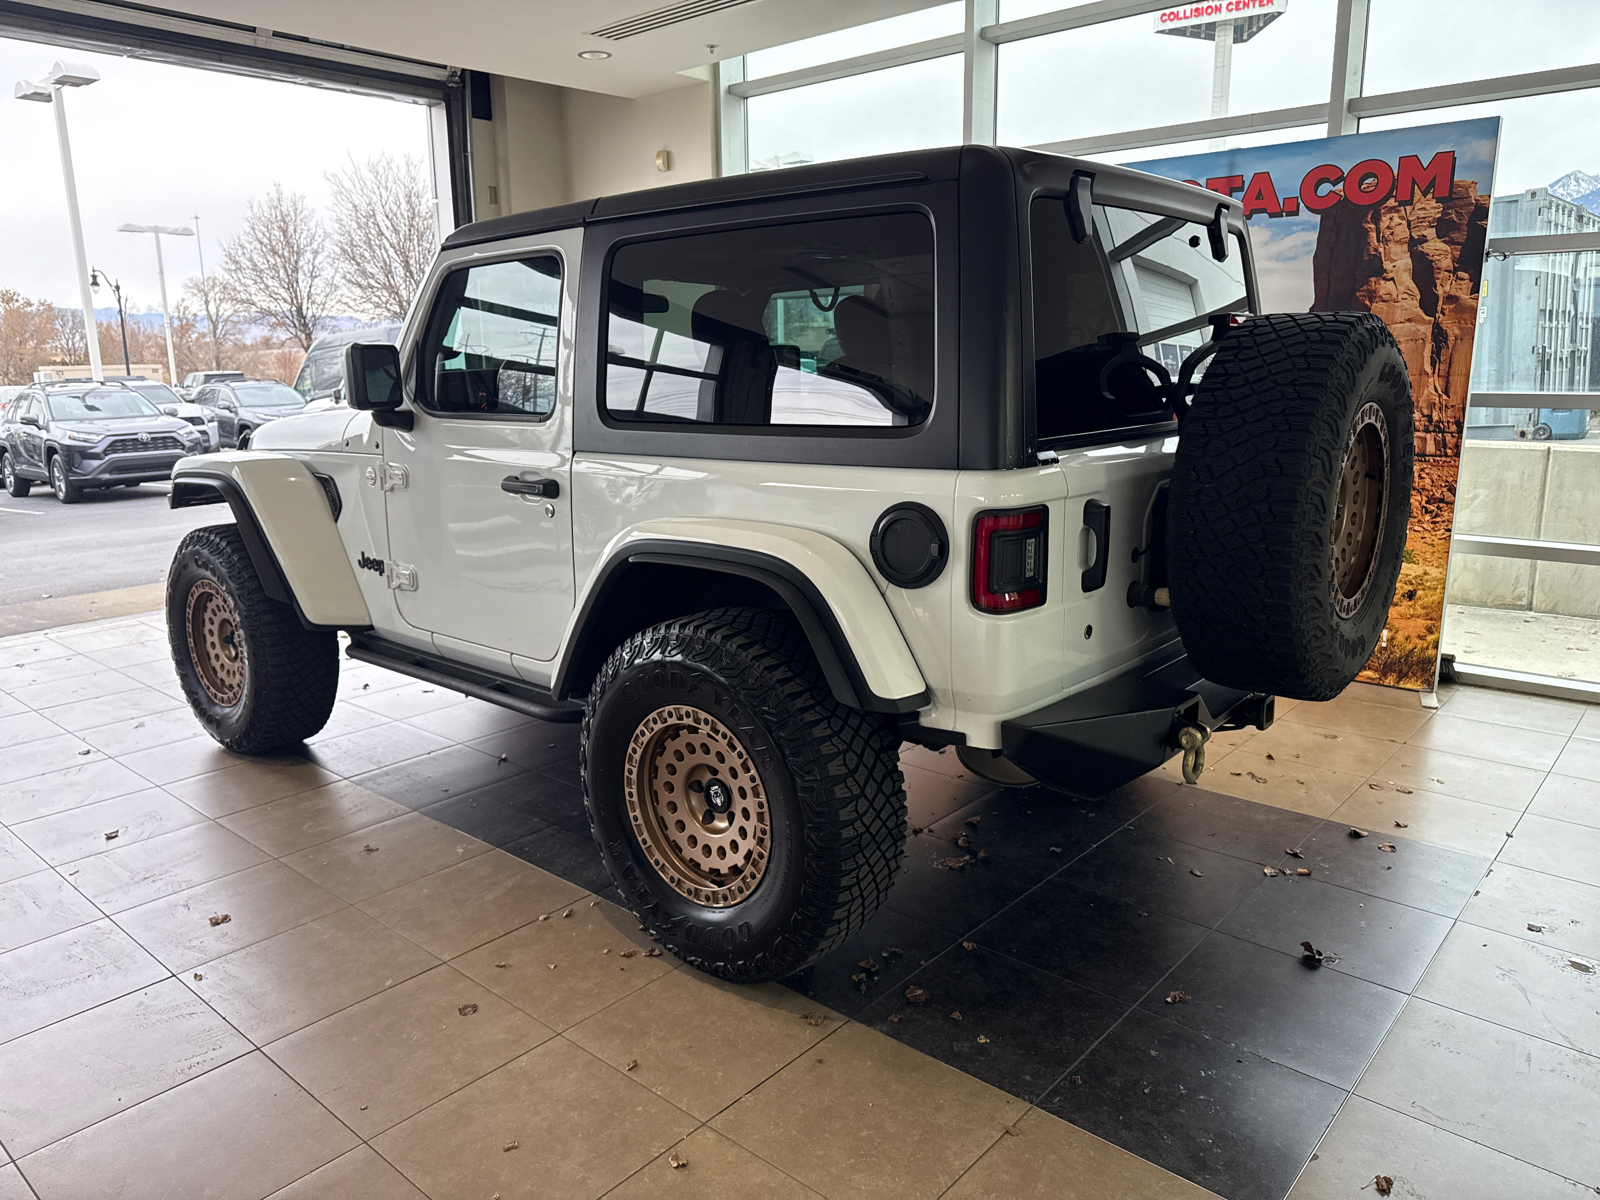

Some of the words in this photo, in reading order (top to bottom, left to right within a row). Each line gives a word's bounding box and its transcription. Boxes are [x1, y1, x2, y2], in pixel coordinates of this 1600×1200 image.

[1159, 3, 1222, 23] COLLISION
[1225, 0, 1274, 12] CENTER
[357, 551, 385, 576] Jeep
